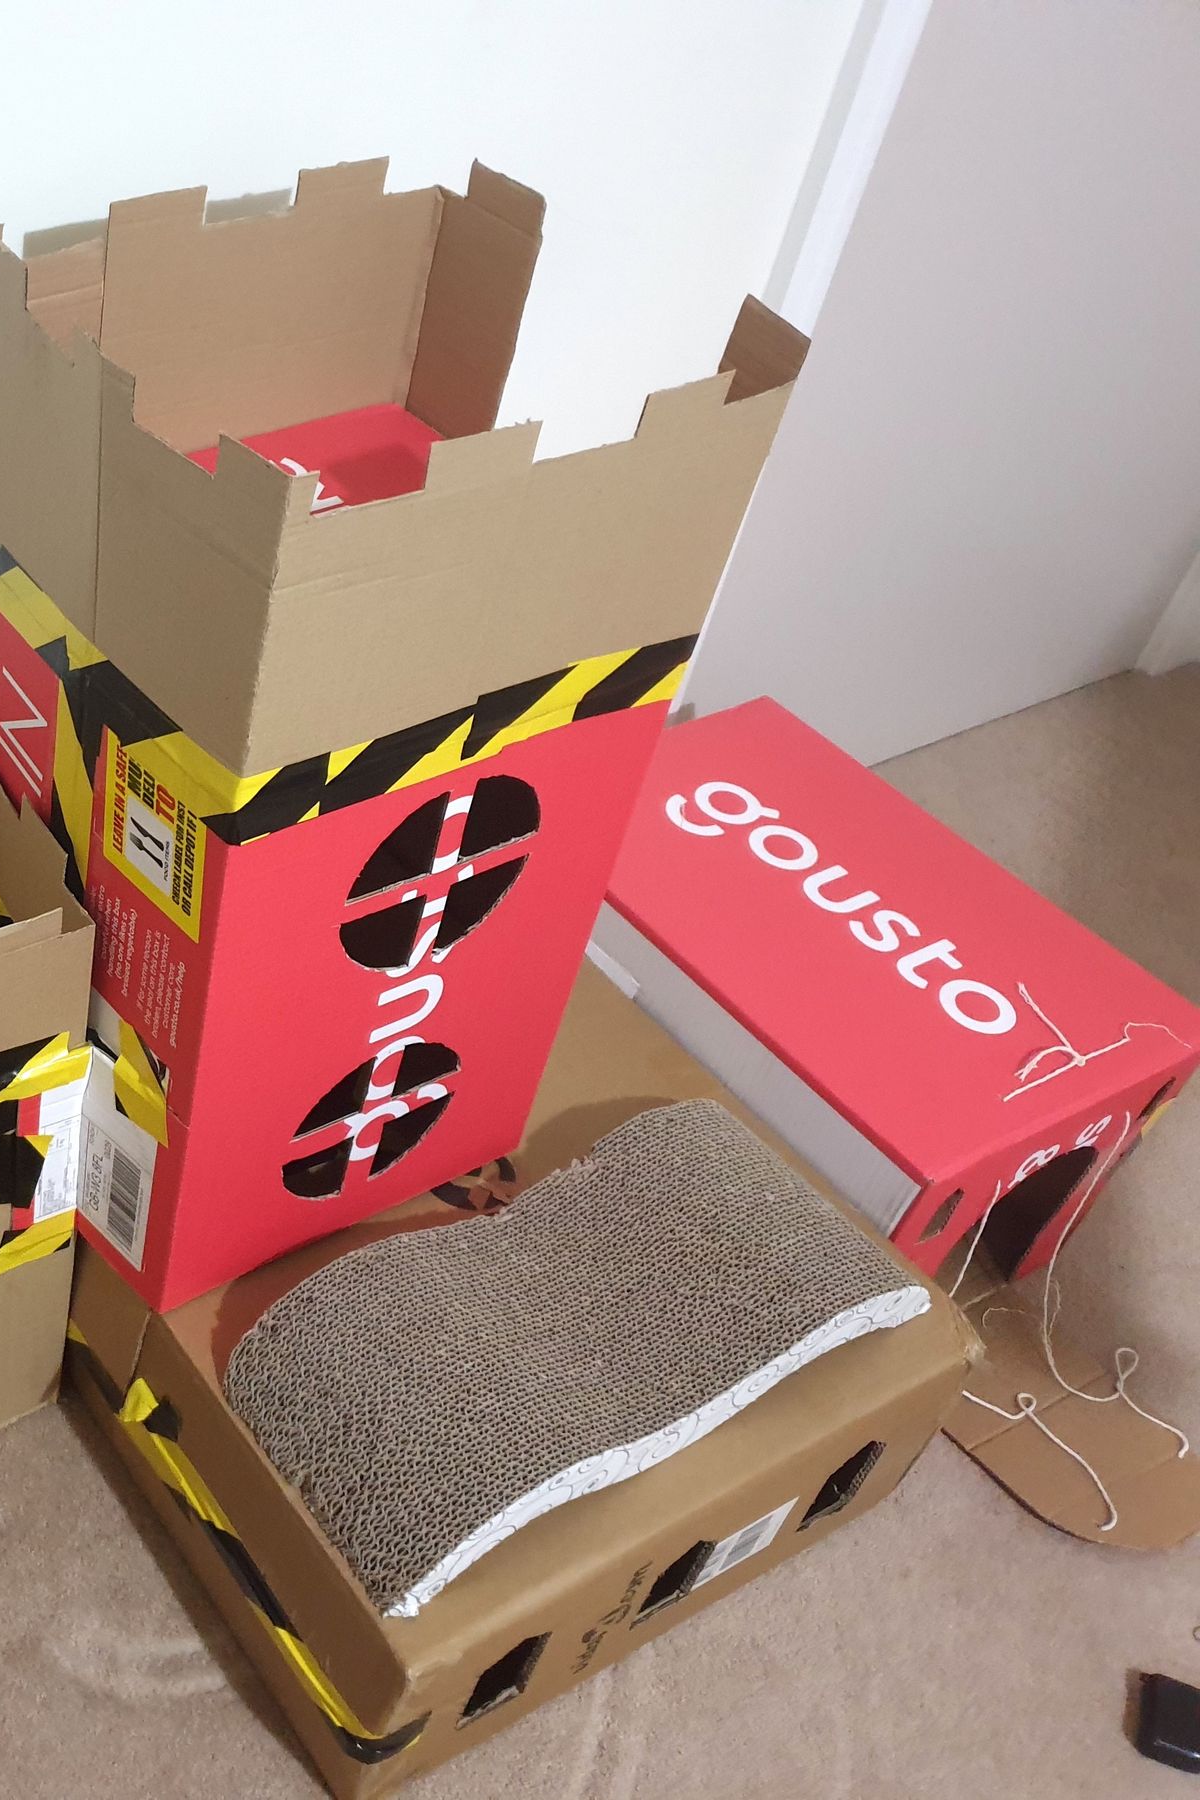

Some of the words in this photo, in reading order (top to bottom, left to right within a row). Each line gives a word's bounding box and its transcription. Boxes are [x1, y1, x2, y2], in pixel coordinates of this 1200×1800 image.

[115, 782, 125, 796] A
[128, 756, 142, 798] MU
[114, 793, 124, 813] IN
[156, 784, 176, 825] TO
[113, 810, 124, 855] LEAVE
[176, 822, 185, 846] FOR
[187, 815, 197, 833] IF
[174, 844, 183, 873] LABEL
[184, 829, 195, 871] DEPOT
[172, 871, 181, 905] CHECK
[183, 869, 193, 899] CALL
[181, 897, 191, 917] OR
[666, 781, 1016, 1034] gousto
[119, 920, 127, 943] likes
[126, 908, 137, 960] vegetable)
[144, 929, 152, 962] reason
[107, 936, 118, 977] handling
[156, 973, 164, 1006] please
[161, 934, 170, 973] contact
[163, 984, 172, 1029] customer
[170, 961, 186, 1048] gousto.co.uk/help
